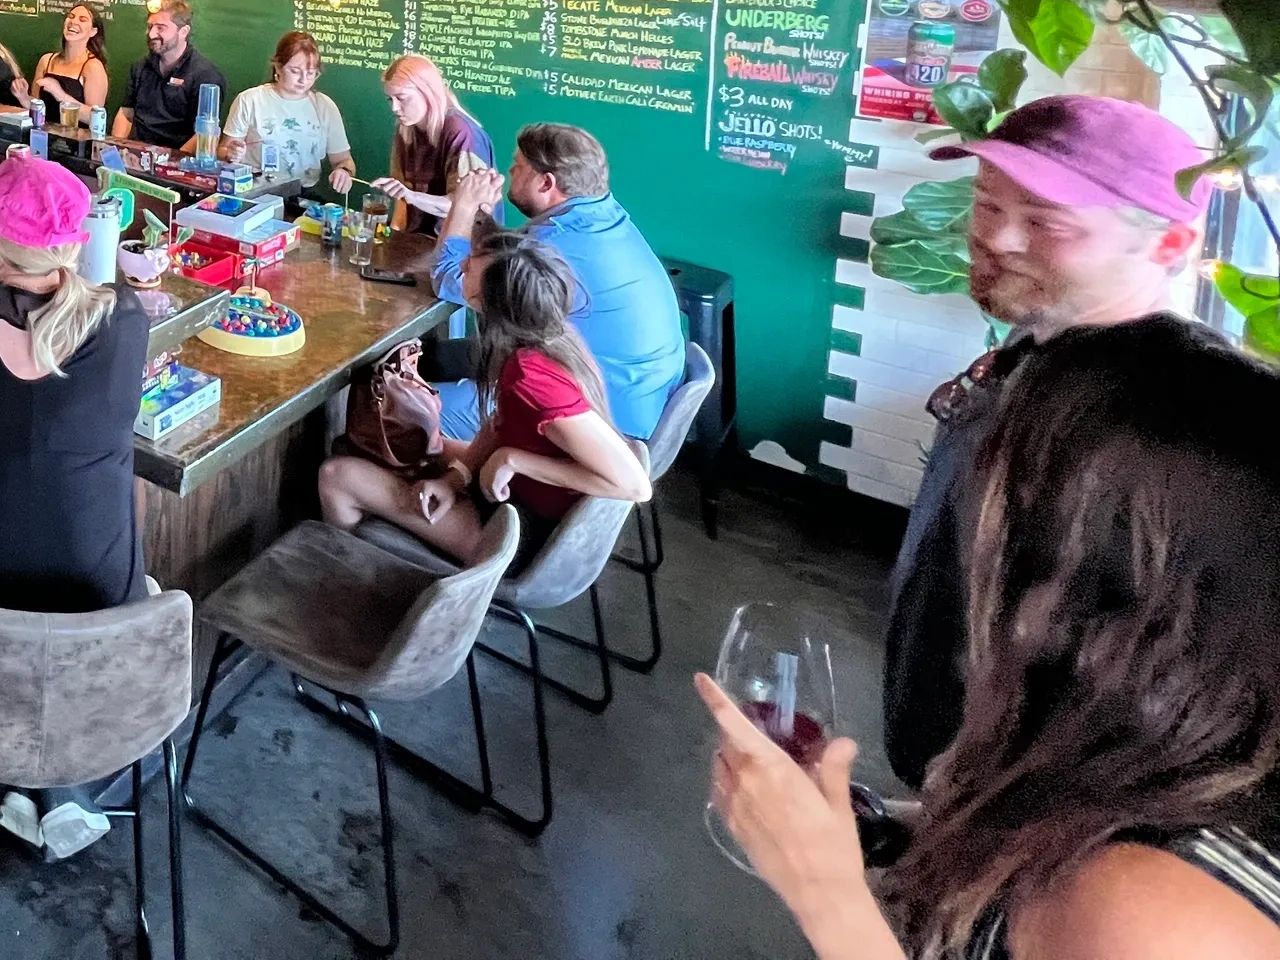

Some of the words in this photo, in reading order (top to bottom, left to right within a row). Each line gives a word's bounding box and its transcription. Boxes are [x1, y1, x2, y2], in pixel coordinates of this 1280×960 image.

[605, 0, 642, 14] MEXICAN
[644, 2, 672, 16] LAGER
[560, 14, 588, 25] STONE
[725, 9, 830, 32] UNDERBERG
[560, 24, 608, 37] TOMBSTONE
[641, 30, 674, 45] HELLES
[562, 35, 581, 47] SLO
[788, 30, 824, 40] SHOTS!
[590, 50, 629, 65] MEXICAN
[631, 56, 662, 70] AMBER
[664, 59, 696, 73] LAGER
[724, 32, 763, 52] PEANUT
[803, 42, 849, 69] WHISKEY
[724, 52, 791, 83] FIREBALL
[543, 83, 557, 95] $5
[560, 85, 598, 101] MOTHER
[598, 90, 625, 104] EARTH
[544, 69, 558, 81] $5
[561, 73, 605, 88] CALIDAD
[608, 78, 653, 94] MEXICAN
[656, 85, 692, 100] LAGER
[864, 87, 911, 99] WHINING
[718, 84, 745, 107] $3
[748, 94, 770, 106] ALL
[771, 97, 794, 111] DAY
[719, 112, 776, 137] JELLO
[779, 121, 823, 139] SHOTS!
